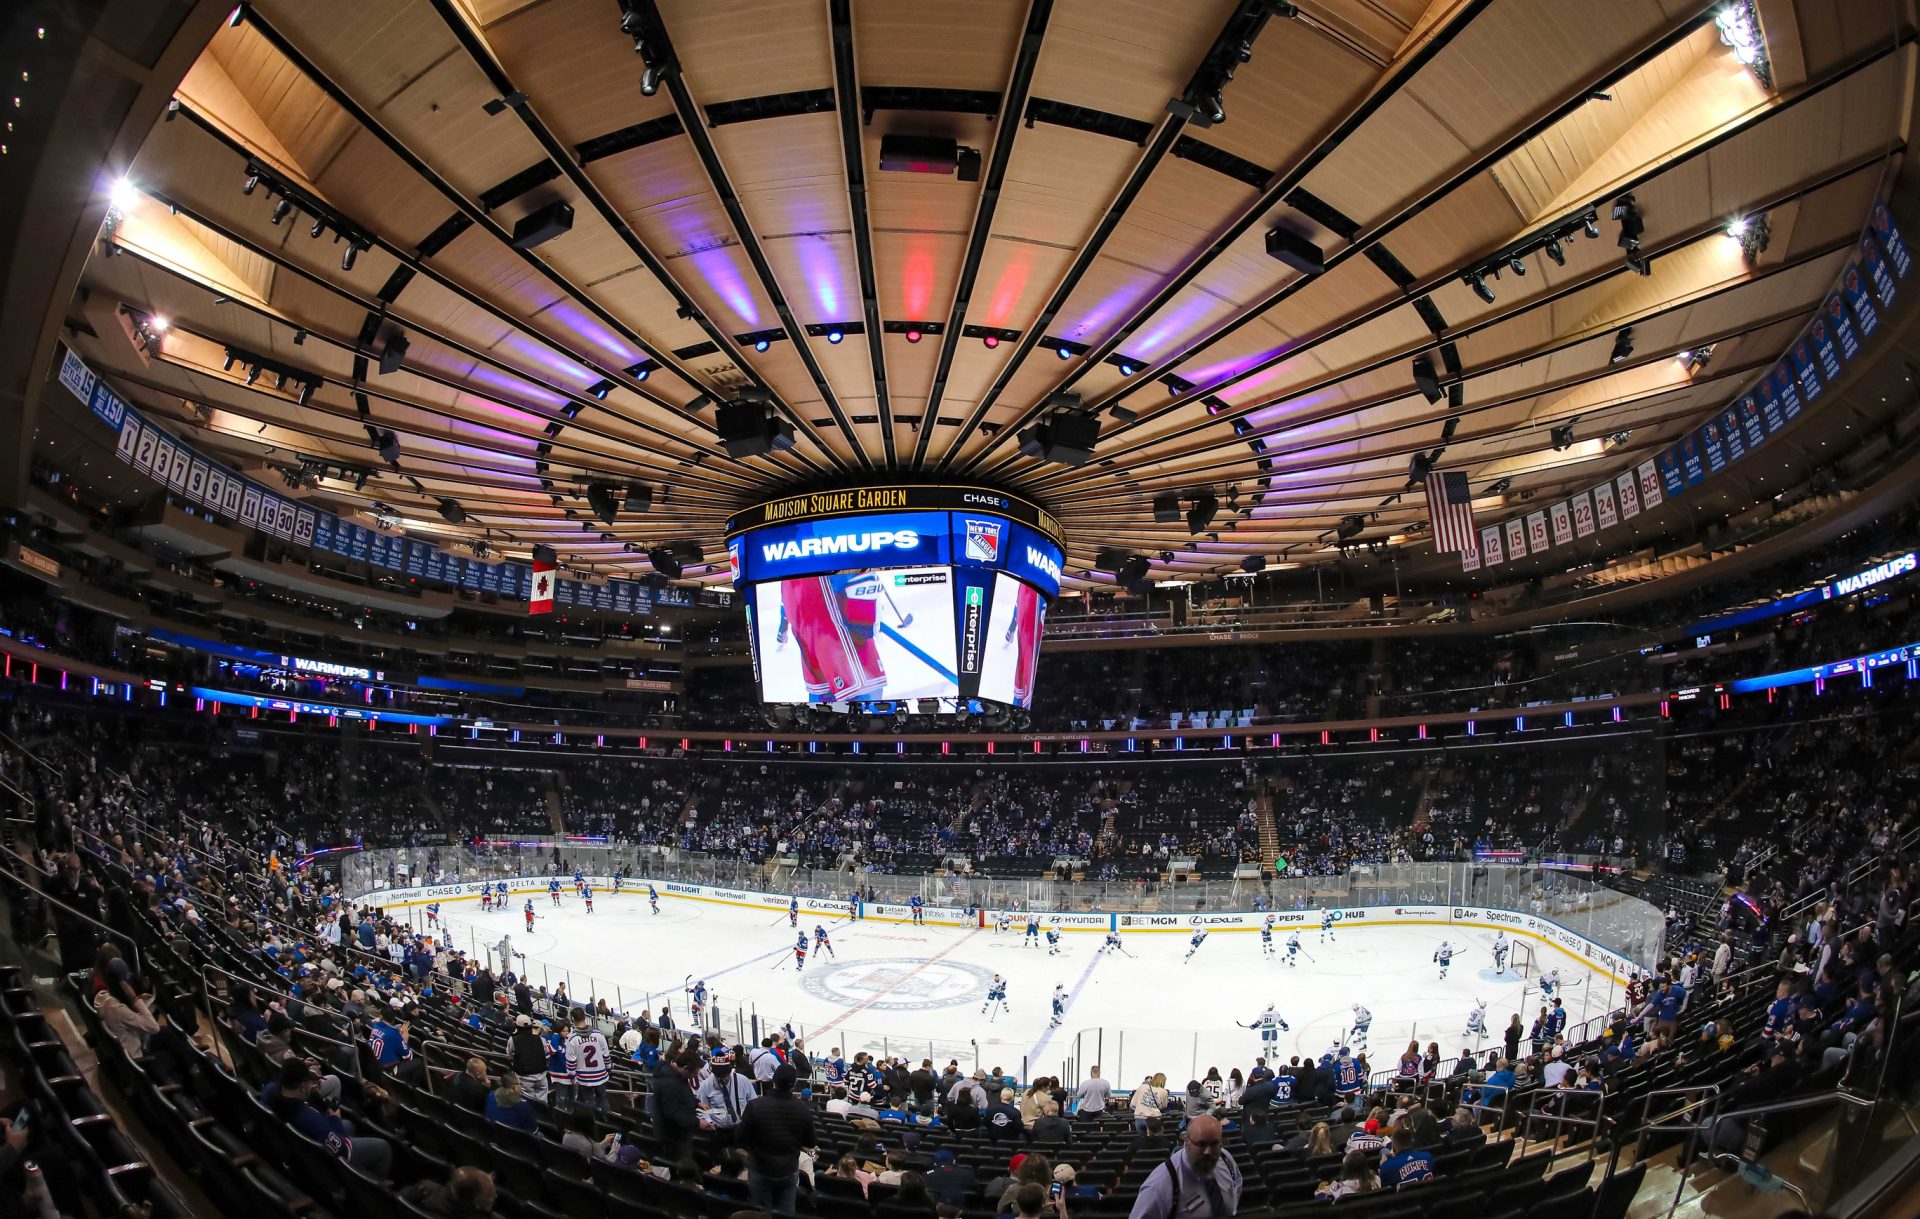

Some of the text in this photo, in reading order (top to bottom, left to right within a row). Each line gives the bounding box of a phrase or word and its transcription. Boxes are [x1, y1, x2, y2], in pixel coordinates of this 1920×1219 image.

[68, 353, 83, 374] HARRY
[62, 363, 81, 387] STYLES
[81, 371, 93, 396] 15
[104, 395, 124, 424] 150
[123, 430, 132, 450] 1
[141, 441, 151, 462] 2
[158, 453, 167, 472] 3
[176, 462, 184, 482] 7
[192, 472, 202, 491] 9
[210, 481, 219, 500] 9
[1641, 473, 1659, 495] 613
[226, 489, 237, 510] 11
[963, 493, 1000, 506] CHASE
[1620, 485, 1635, 505] 33
[243, 499, 256, 519] 11
[764, 489, 907, 521] MADISON SQUARE GARDEN
[1575, 505, 1591, 524] 22
[1598, 495, 1614, 515] 24
[261, 506, 276, 525] 19
[278, 512, 293, 532] 30
[1555, 514, 1568, 532] 19
[296, 519, 312, 538] 35
[969, 525, 998, 534] NEW YORK
[1531, 523, 1544, 540] 15
[763, 530, 919, 562] WARMUPS
[973, 534, 996, 560] RANGERS
[1486, 538, 1499, 554] 12
[1510, 531, 1522, 548] 15
[897, 574, 946, 584] enterprise
[1836, 553, 1916, 595] WARMUPS
[965, 589, 979, 671] enterprise
[295, 658, 369, 679] WARMUPS
[427, 887, 454, 896] CHASE
[510, 880, 535, 888] DELTA
[666, 883, 701, 895] BUD LIGHT
[390, 890, 422, 900] Northwell
[714, 890, 746, 900] Northwell
[763, 896, 789, 905] verizon
[818, 902, 850, 911] LEXUS
[1345, 911, 1365, 919] HUB
[1395, 908, 1437, 917] Champion
[1131, 917, 1177, 925] BETMGM
[1279, 914, 1304, 922] PEPSI
[1486, 910, 1520, 924] Spectrum
[1537, 924, 1556, 936] HYUNDAI
[1559, 931, 1576, 947] CHASE
[1591, 944, 1616, 967] BETMGM
[577, 1035, 598, 1045] LEETCH
[583, 1044, 599, 1068] 2
[849, 1075, 865, 1092] 27
[1340, 1067, 1357, 1084] 10
[1276, 1085, 1291, 1100] 43
[1358, 1140, 1380, 1150] LEETC
